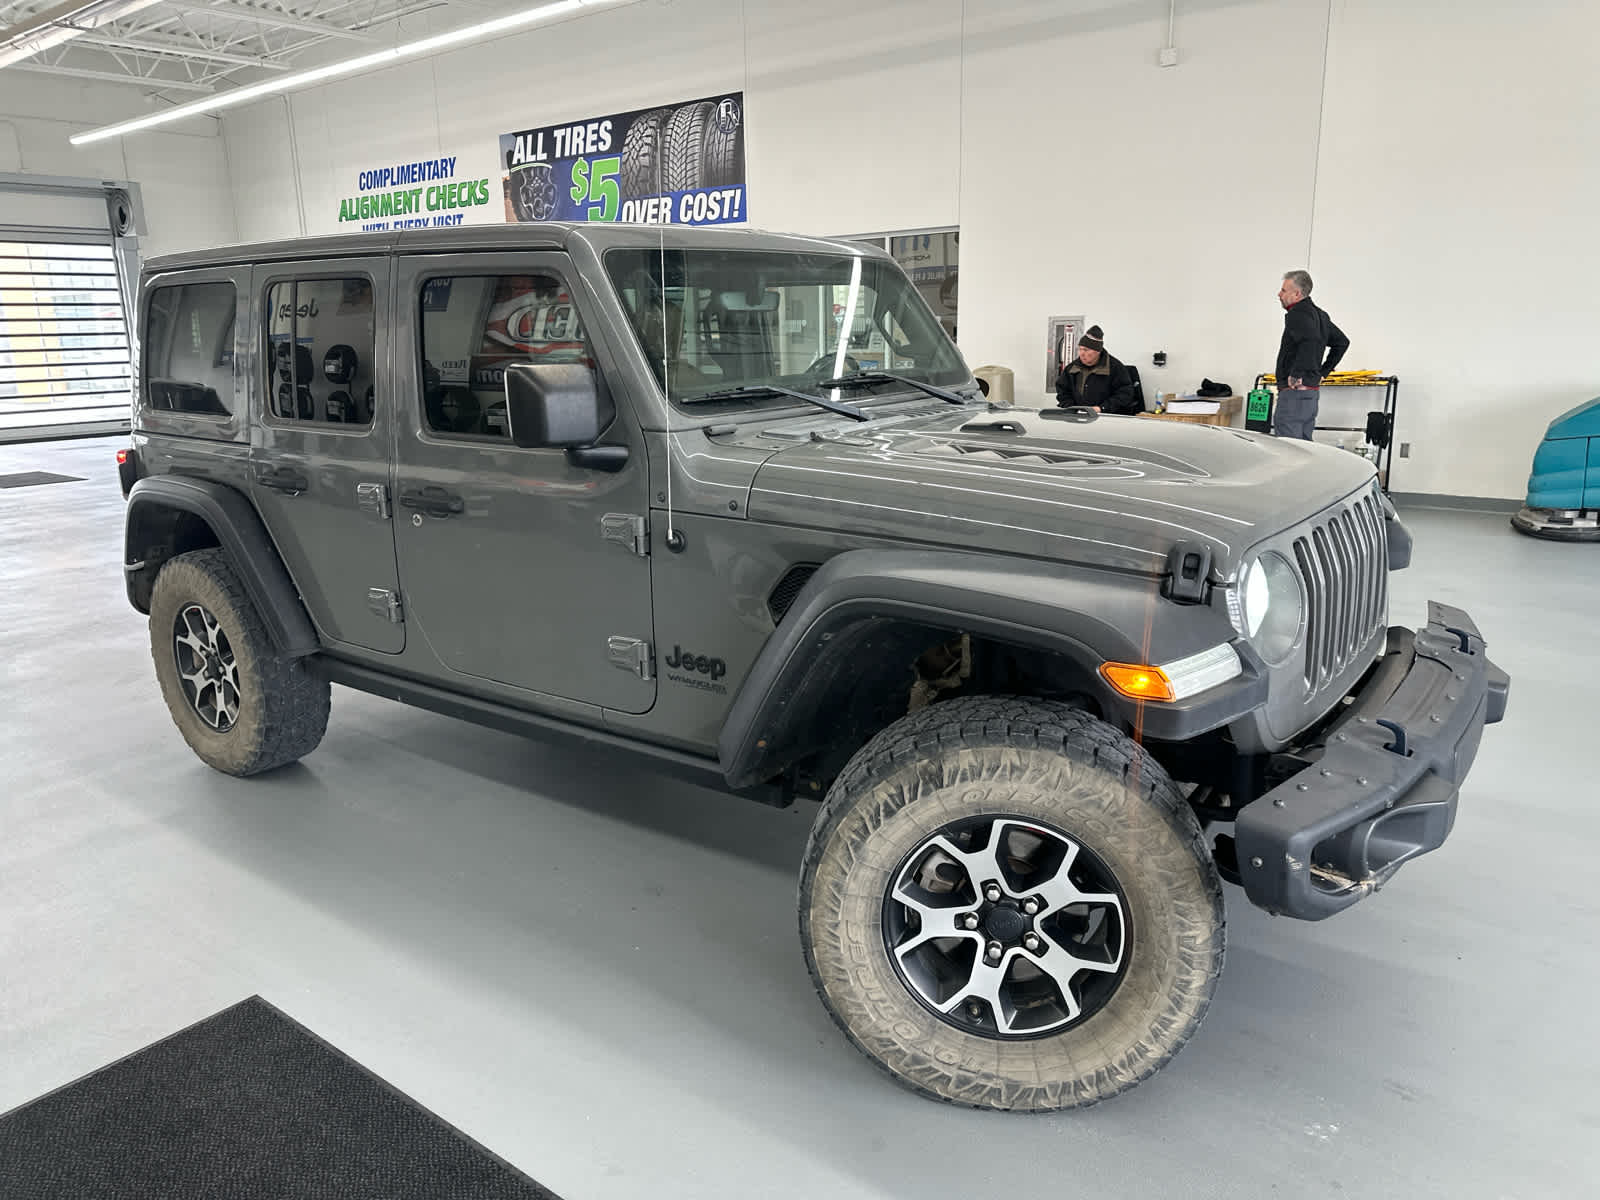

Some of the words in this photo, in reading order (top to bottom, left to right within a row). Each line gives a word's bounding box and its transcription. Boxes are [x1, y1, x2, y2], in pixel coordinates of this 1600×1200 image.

[512, 132, 548, 165] ALL
[553, 120, 613, 159] TIRES
[359, 157, 457, 191] COMPLIMENTARY
[570, 157, 620, 222] $5
[339, 187, 423, 222] ALIGNMENT
[426, 178, 489, 212] CHECKS
[622, 197, 672, 223] OVER
[680, 188, 742, 223] COST!
[665, 645, 727, 680] Jeep
